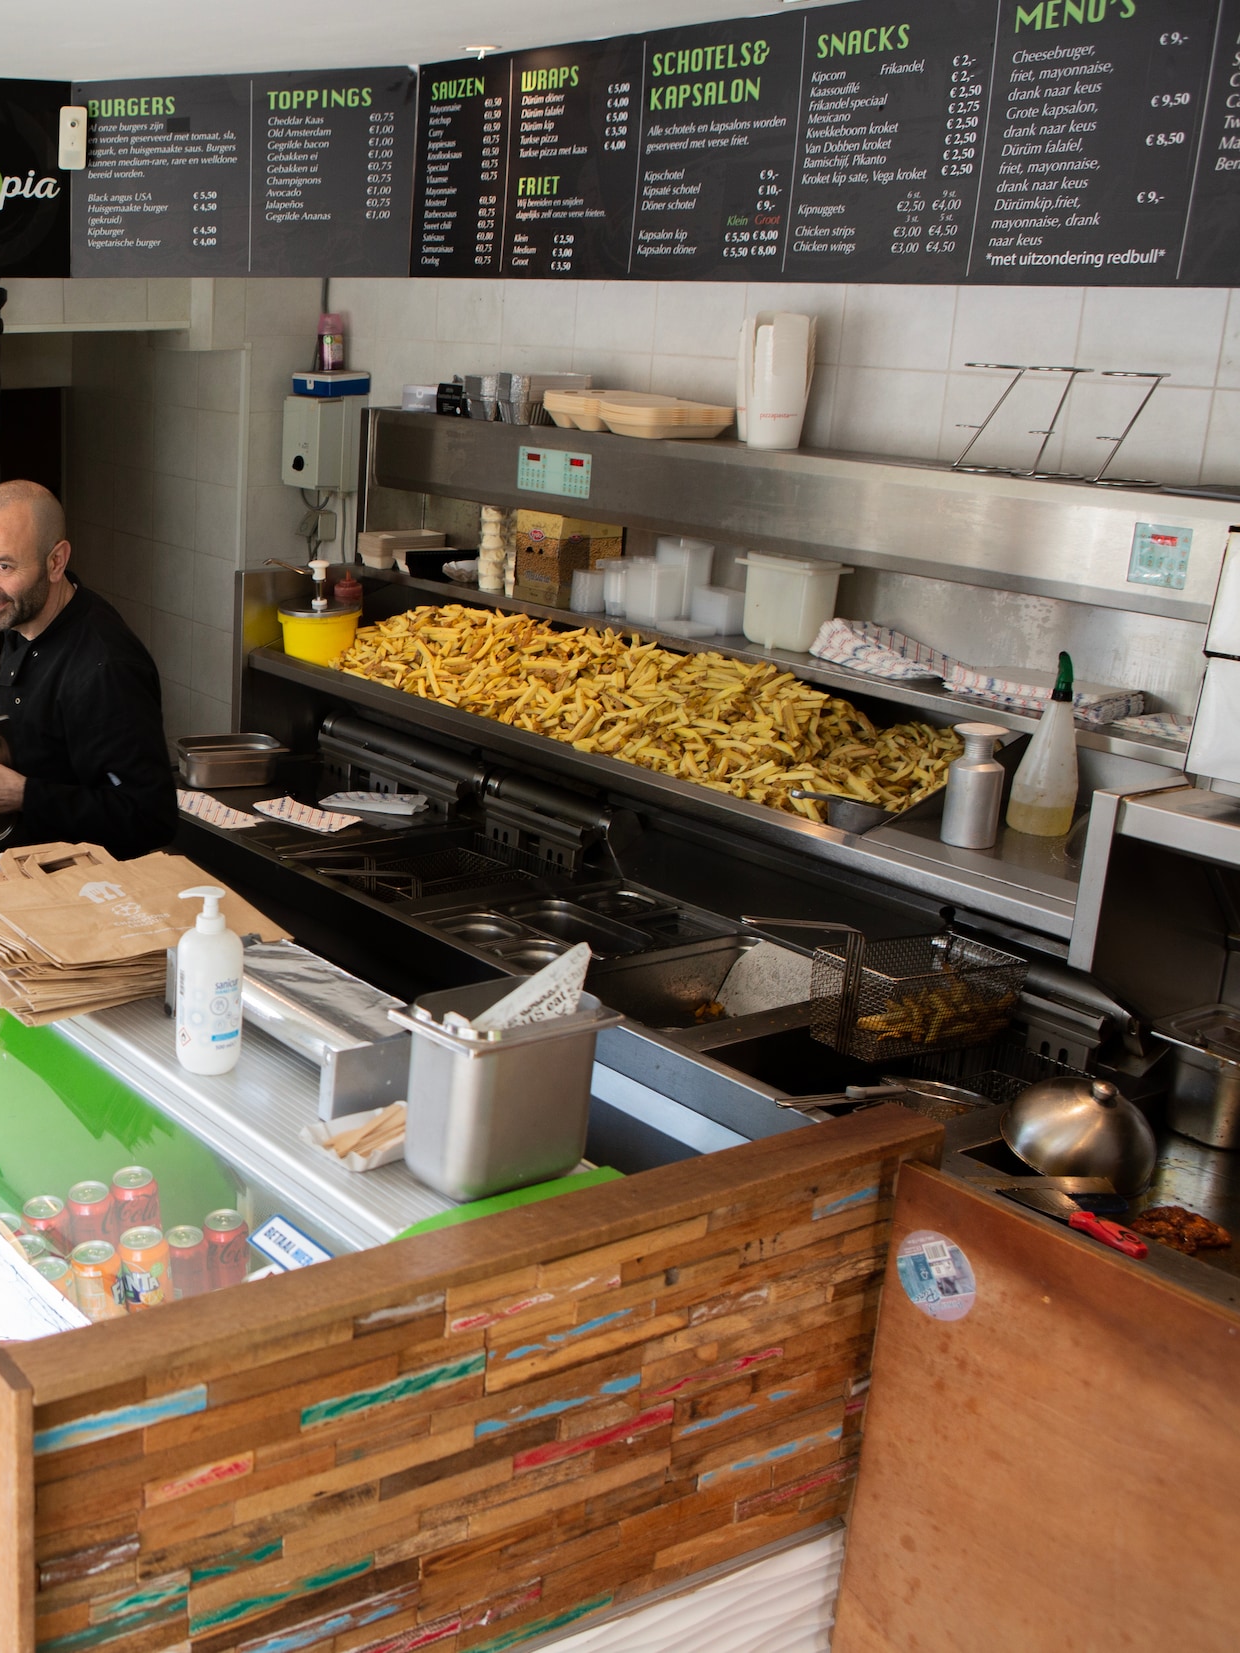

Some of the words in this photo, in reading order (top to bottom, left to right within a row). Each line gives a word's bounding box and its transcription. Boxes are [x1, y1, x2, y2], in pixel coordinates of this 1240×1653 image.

[817, 24, 910, 58] SNACKS
[652, 40, 770, 77] SCHOTELS&
[1013, 45, 1096, 64] Cheesebruger,
[880, 59, 925, 75] Frikandel,
[1010, 68, 1035, 83] friet,
[1039, 61, 1114, 80] mayonnaise,
[521, 66, 579, 92] WRAPS
[811, 70, 846, 84] Kipcorn
[432, 76, 485, 100] SAUZEN
[650, 76, 760, 111] KAPSALON
[810, 82, 860, 98] Kaassoufflé
[1008, 87, 1041, 101] drank
[1044, 84, 1071, 96] naar
[1074, 81, 1102, 94] keus
[267, 88, 372, 110] TOPPINGS
[809, 97, 850, 111] Frikandel
[850, 94, 888, 110] speciaal
[1161, 93, 1190, 107] 9,50
[88, 96, 176, 118] BURGERS
[1006, 107, 1039, 120] Grote
[1042, 101, 1098, 119] kapsalon,
[268, 116, 302, 126] Cheddar
[305, 116, 324, 124] Kaas
[370, 112, 394, 122] €0,75
[808, 112, 851, 124] Mexicano
[98, 123, 117, 132] onze
[119, 122, 147, 133] burgers
[150, 122, 164, 132] zijn
[268, 128, 283, 137] Old
[285, 127, 331, 137] Amsterdam
[369, 125, 394, 134] €1,00
[647, 126, 663, 137] Alle
[664, 122, 695, 136] schotels
[698, 125, 707, 133] en
[710, 119, 751, 134] kapsalons
[753, 116, 786, 128] worden
[806, 125, 867, 139] Kwekkeboom
[869, 122, 899, 134] kroket
[1004, 125, 1036, 139] drank
[1039, 123, 1066, 135] naar
[1069, 120, 1097, 132] keus
[100, 135, 129, 143] worden
[130, 132, 172, 145] geserveerd
[174, 133, 189, 141] met
[191, 132, 221, 141] tomaat,
[223, 131, 236, 140] sla,
[368, 137, 393, 147] €1,00
[130, 145, 182, 156] huisgemaakte
[206, 144, 236, 154] Burgers
[268, 140, 302, 151] Gegrilde
[304, 140, 329, 148] bacon
[646, 138, 688, 155] geserveerd
[690, 139, 705, 149] met
[708, 138, 729, 147] verse
[731, 135, 750, 146] friet.
[805, 143, 821, 154] Van
[823, 141, 860, 153] Dobben
[862, 139, 892, 151] kroket
[1001, 144, 1041, 157] Dürüm
[1045, 139, 1084, 153] falafel,
[267, 152, 308, 161] Gebakken
[310, 152, 318, 160] ei
[368, 149, 393, 159] €1,00
[118, 156, 169, 167] medium-rare,
[201, 155, 237, 164] welldone
[368, 162, 392, 172] €0,75
[803, 155, 850, 170] Bamischijf,
[852, 154, 886, 166] Pikanto
[88, 170, 111, 179] bereid
[114, 170, 145, 178] worden.
[267, 165, 307, 174] Gebakken
[310, 164, 318, 173] ui
[644, 168, 685, 183] Kipschotel
[266, 177, 322, 187] Champignons
[367, 174, 391, 184] €0,75
[801, 173, 830, 184] Kroket
[832, 172, 846, 186] kip
[872, 170, 894, 184] Vega
[896, 168, 927, 180] kroket
[266, 188, 301, 197] Avocado
[367, 186, 391, 196] €1,00
[518, 176, 560, 196] FRIET
[643, 185, 671, 199] Kipsaté
[672, 183, 701, 194] schotel
[88, 193, 108, 202] Black
[110, 194, 132, 203] angus
[135, 193, 152, 201] USA
[200, 191, 217, 200] 5,50
[88, 204, 141, 214] Huisgemaakte
[143, 203, 168, 213] burger
[266, 200, 304, 210] Jalapeños
[366, 198, 390, 208] €0,75
[642, 200, 666, 210] Döner
[667, 199, 696, 210] schotel
[897, 201, 925, 212] €2,50
[932, 199, 961, 211] €4,00
[366, 210, 390, 220] €1,00
[798, 204, 846, 217] Kipnuggets
[88, 216, 122, 225] (gekruid)
[266, 212, 299, 223] Gegrilde
[301, 212, 331, 220] Ananas
[727, 216, 748, 226] Klein
[754, 214, 780, 225] Groot
[991, 217, 1062, 231] mayonnaise,
[1065, 212, 1101, 227] drank
[88, 227, 125, 237] Kipburger
[638, 229, 673, 242] Kapsalon
[675, 229, 687, 241] kip
[795, 226, 830, 237] Chicken
[831, 227, 855, 239] strips
[893, 226, 921, 238] €3,00
[928, 225, 958, 237] €4,50
[88, 239, 134, 248] Vegetarische
[136, 239, 161, 248] burger
[989, 235, 1014, 246] naar
[1016, 234, 1042, 246] keus
[793, 241, 828, 252] Chicken
[830, 242, 856, 254] wings
[1019, 250, 1104, 267] uitzondering
